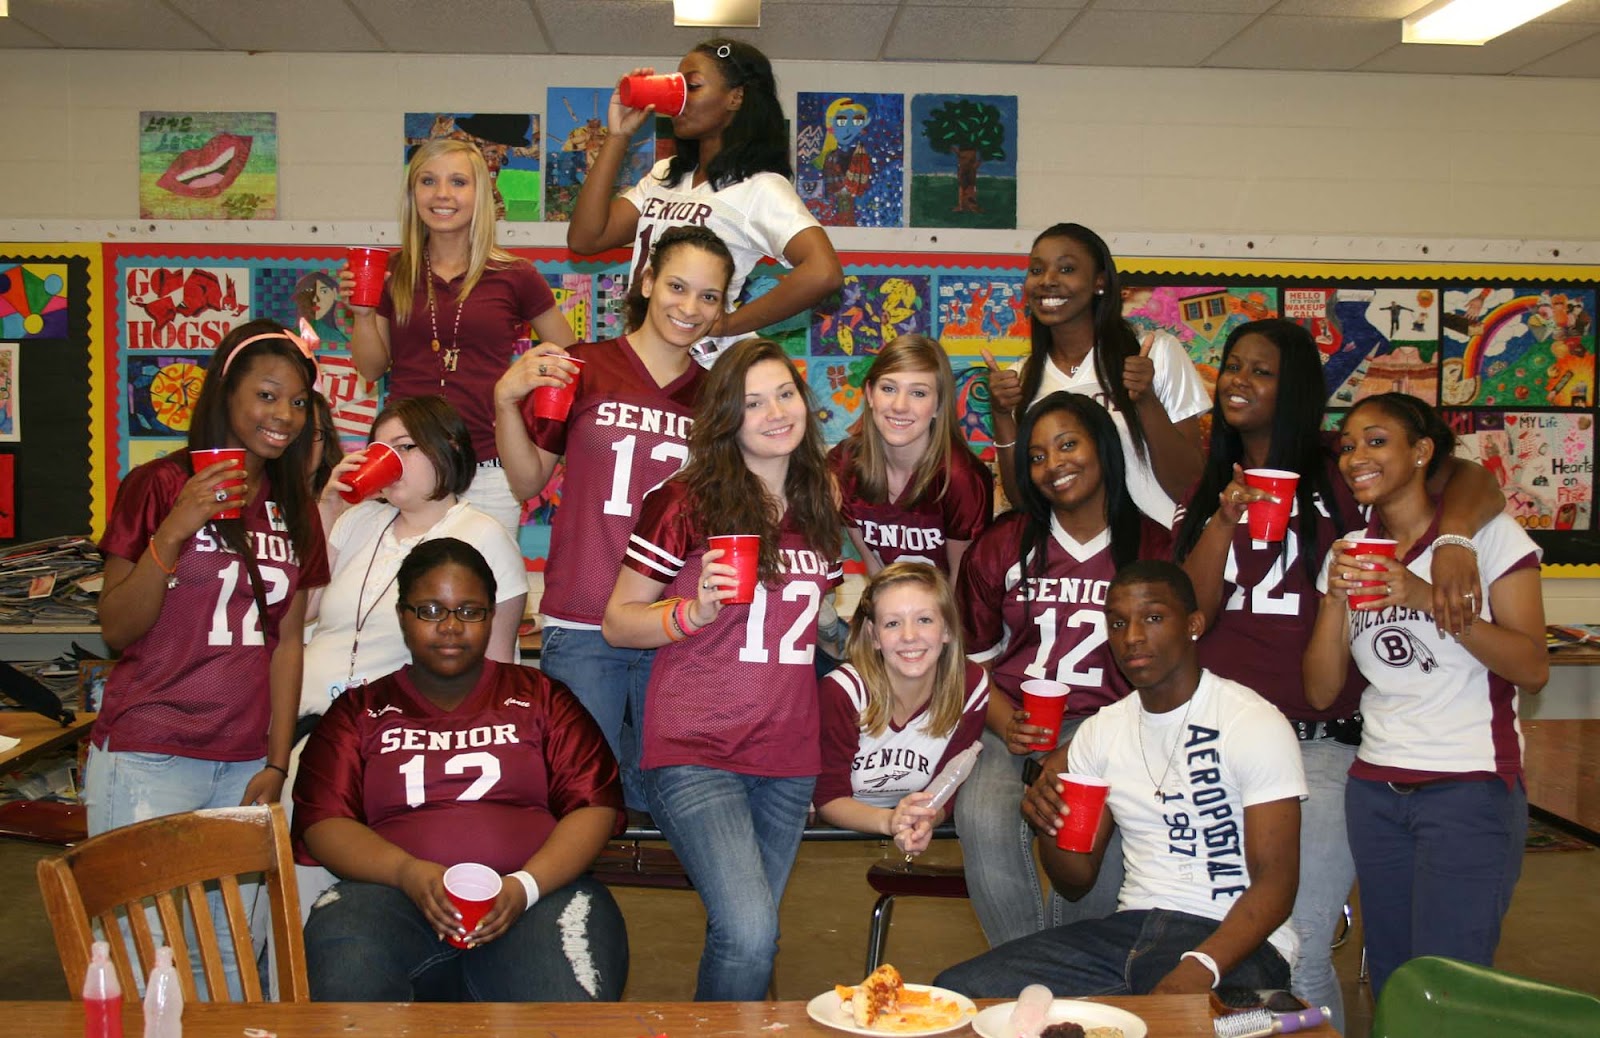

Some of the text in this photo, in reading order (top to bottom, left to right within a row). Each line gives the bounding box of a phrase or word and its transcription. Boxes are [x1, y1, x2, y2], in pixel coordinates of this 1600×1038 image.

[595, 402, 696, 440] SENIO
[1519, 416, 1536, 428] MY
[1552, 455, 1593, 475] Hearts
[1562, 477, 1578, 486] on
[195, 523, 300, 567] SIO
[855, 519, 945, 551] ENIOR
[777, 549, 829, 576] IOR
[208, 561, 290, 646] 12
[1016, 577, 1111, 605] SENIO
[739, 580, 820, 665] 12
[1024, 607, 1109, 687] 12
[1381, 635, 1408, 661] B
[380, 723, 520, 754] SENIOR
[852, 748, 930, 775] SENIOR
[399, 751, 502, 808] 12
[1162, 792, 1197, 858] 1987
